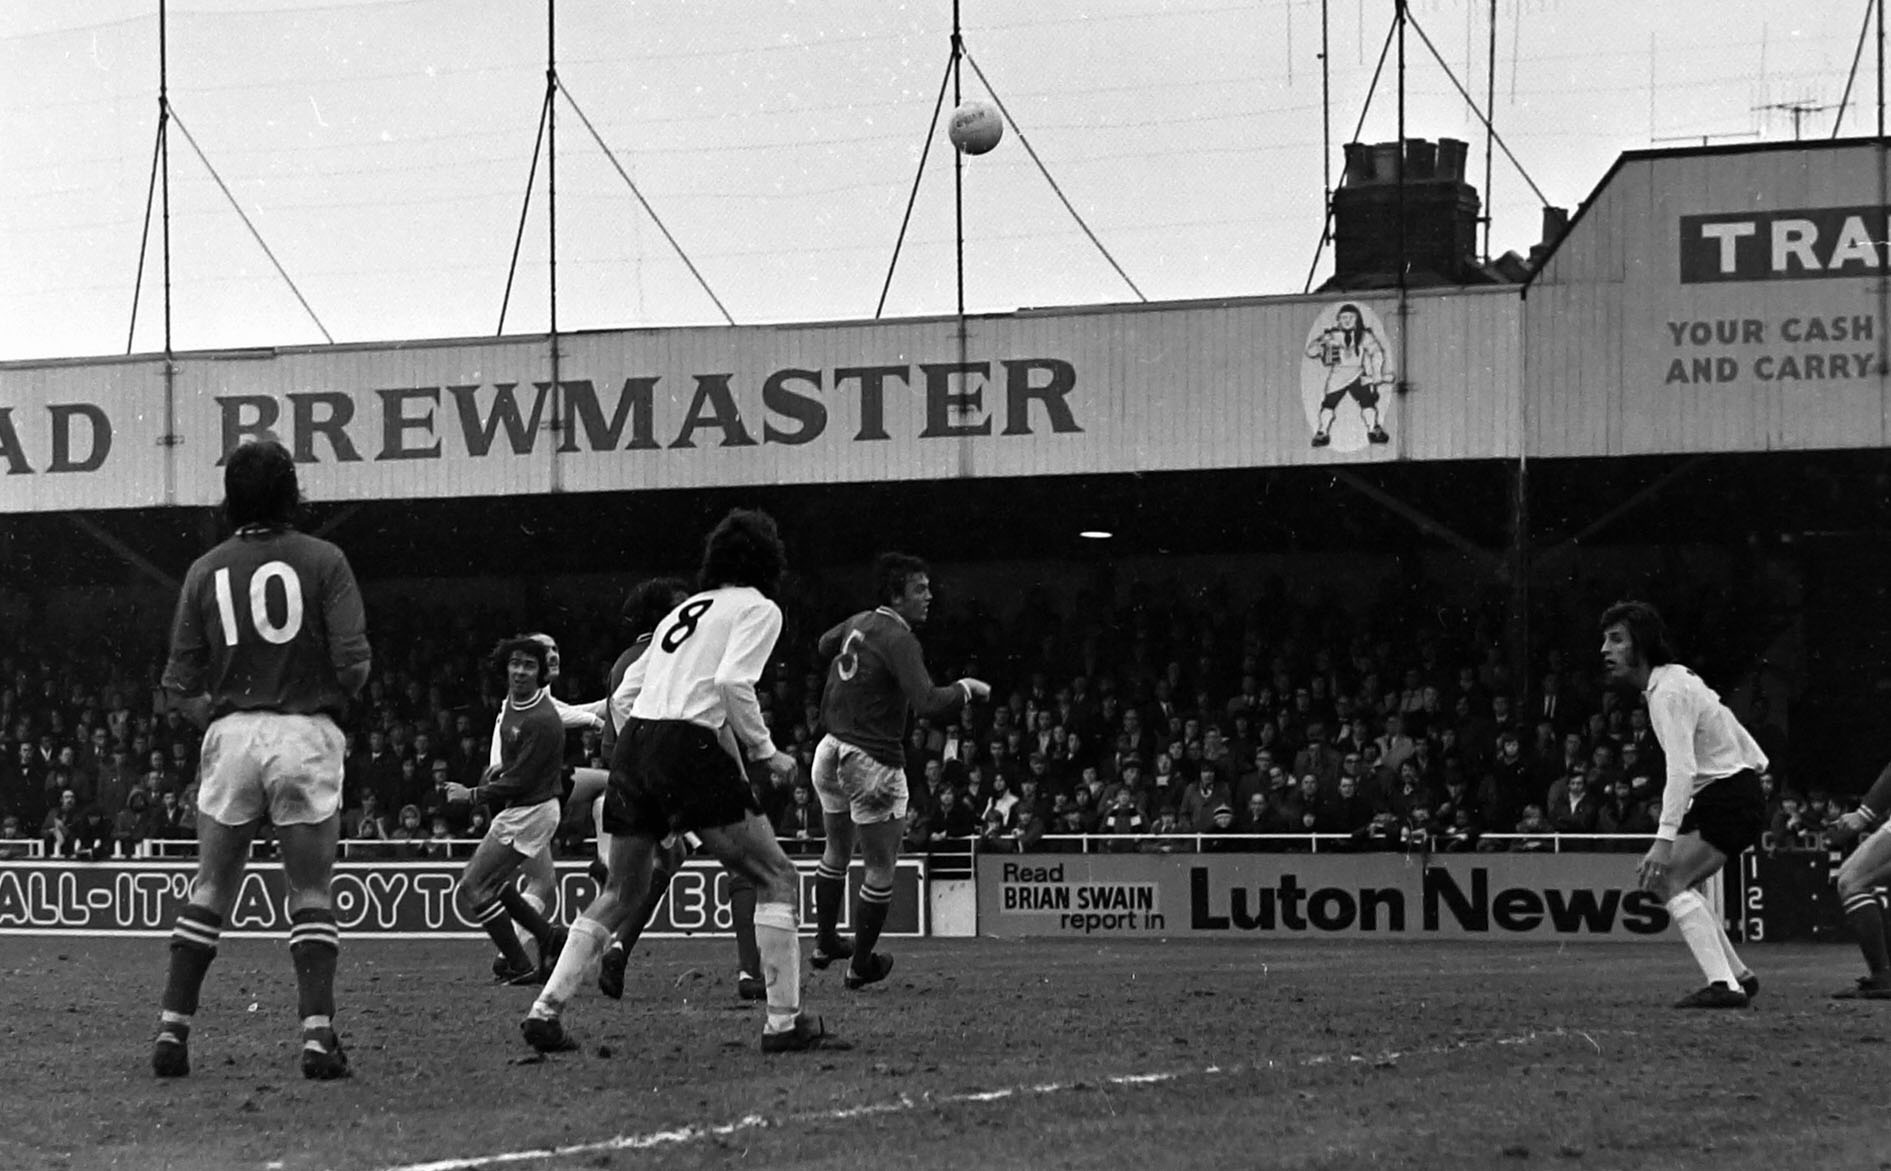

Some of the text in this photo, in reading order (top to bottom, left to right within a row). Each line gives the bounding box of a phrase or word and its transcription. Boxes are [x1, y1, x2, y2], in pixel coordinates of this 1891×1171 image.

[1702, 215, 1891, 273] TRA
[1667, 315, 1873, 346] YOUR CASH
[1665, 353, 1874, 384] AND CARRY
[214, 358, 1085, 468] BREWMASTER
[215, 561, 304, 647] 10
[661, 598, 714, 654] 8
[1003, 862, 1065, 883] Read
[1752, 855, 1757, 879] 1
[0, 871, 201, 926] ALL-IT'
[231, 873, 276, 927] A
[1003, 886, 1154, 910] BRIAN SWAIN
[1190, 866, 1671, 935] Luton News
[1748, 886, 1763, 910] 2
[1060, 910, 1166, 934] report in
[1749, 917, 1764, 941] 3
